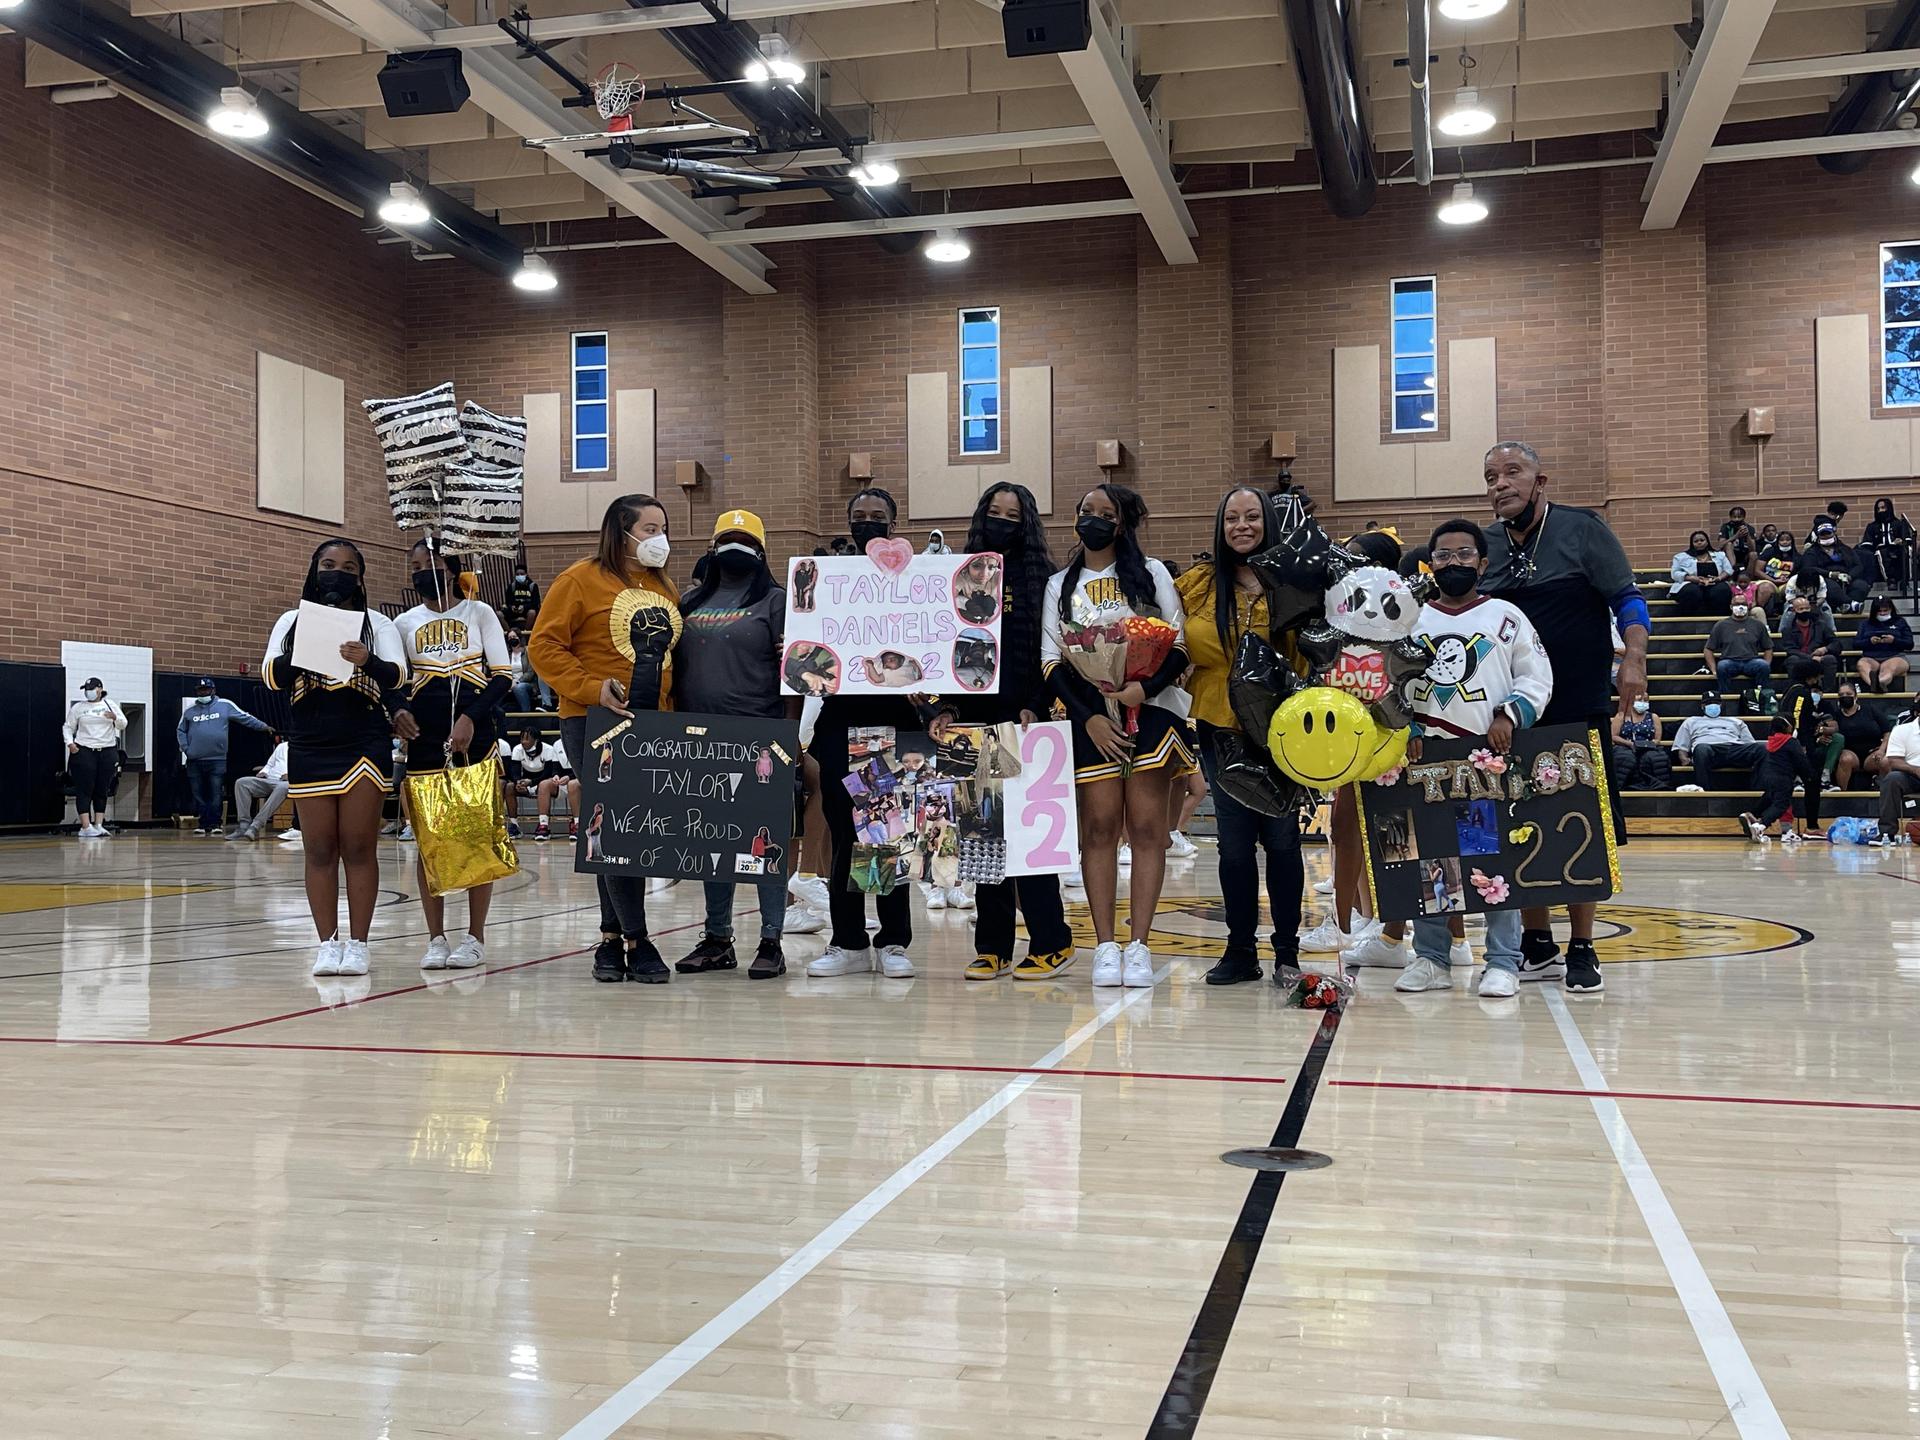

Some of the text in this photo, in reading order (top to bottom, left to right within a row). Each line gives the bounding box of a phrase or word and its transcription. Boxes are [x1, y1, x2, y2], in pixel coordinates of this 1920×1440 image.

[825, 574, 948, 604] TAYLOR
[1498, 616, 1516, 643] C
[424, 641, 460, 657] eagles
[1340, 657, 1347, 672] I
[1330, 668, 1383, 688] LOVE
[621, 734, 760, 763] CONGRATULATIONS
[641, 768, 744, 802] TAYLOR!
[610, 804, 743, 841] WE ARE PROUD
[639, 846, 664, 868] OF
[740, 864, 758, 872] 2022
